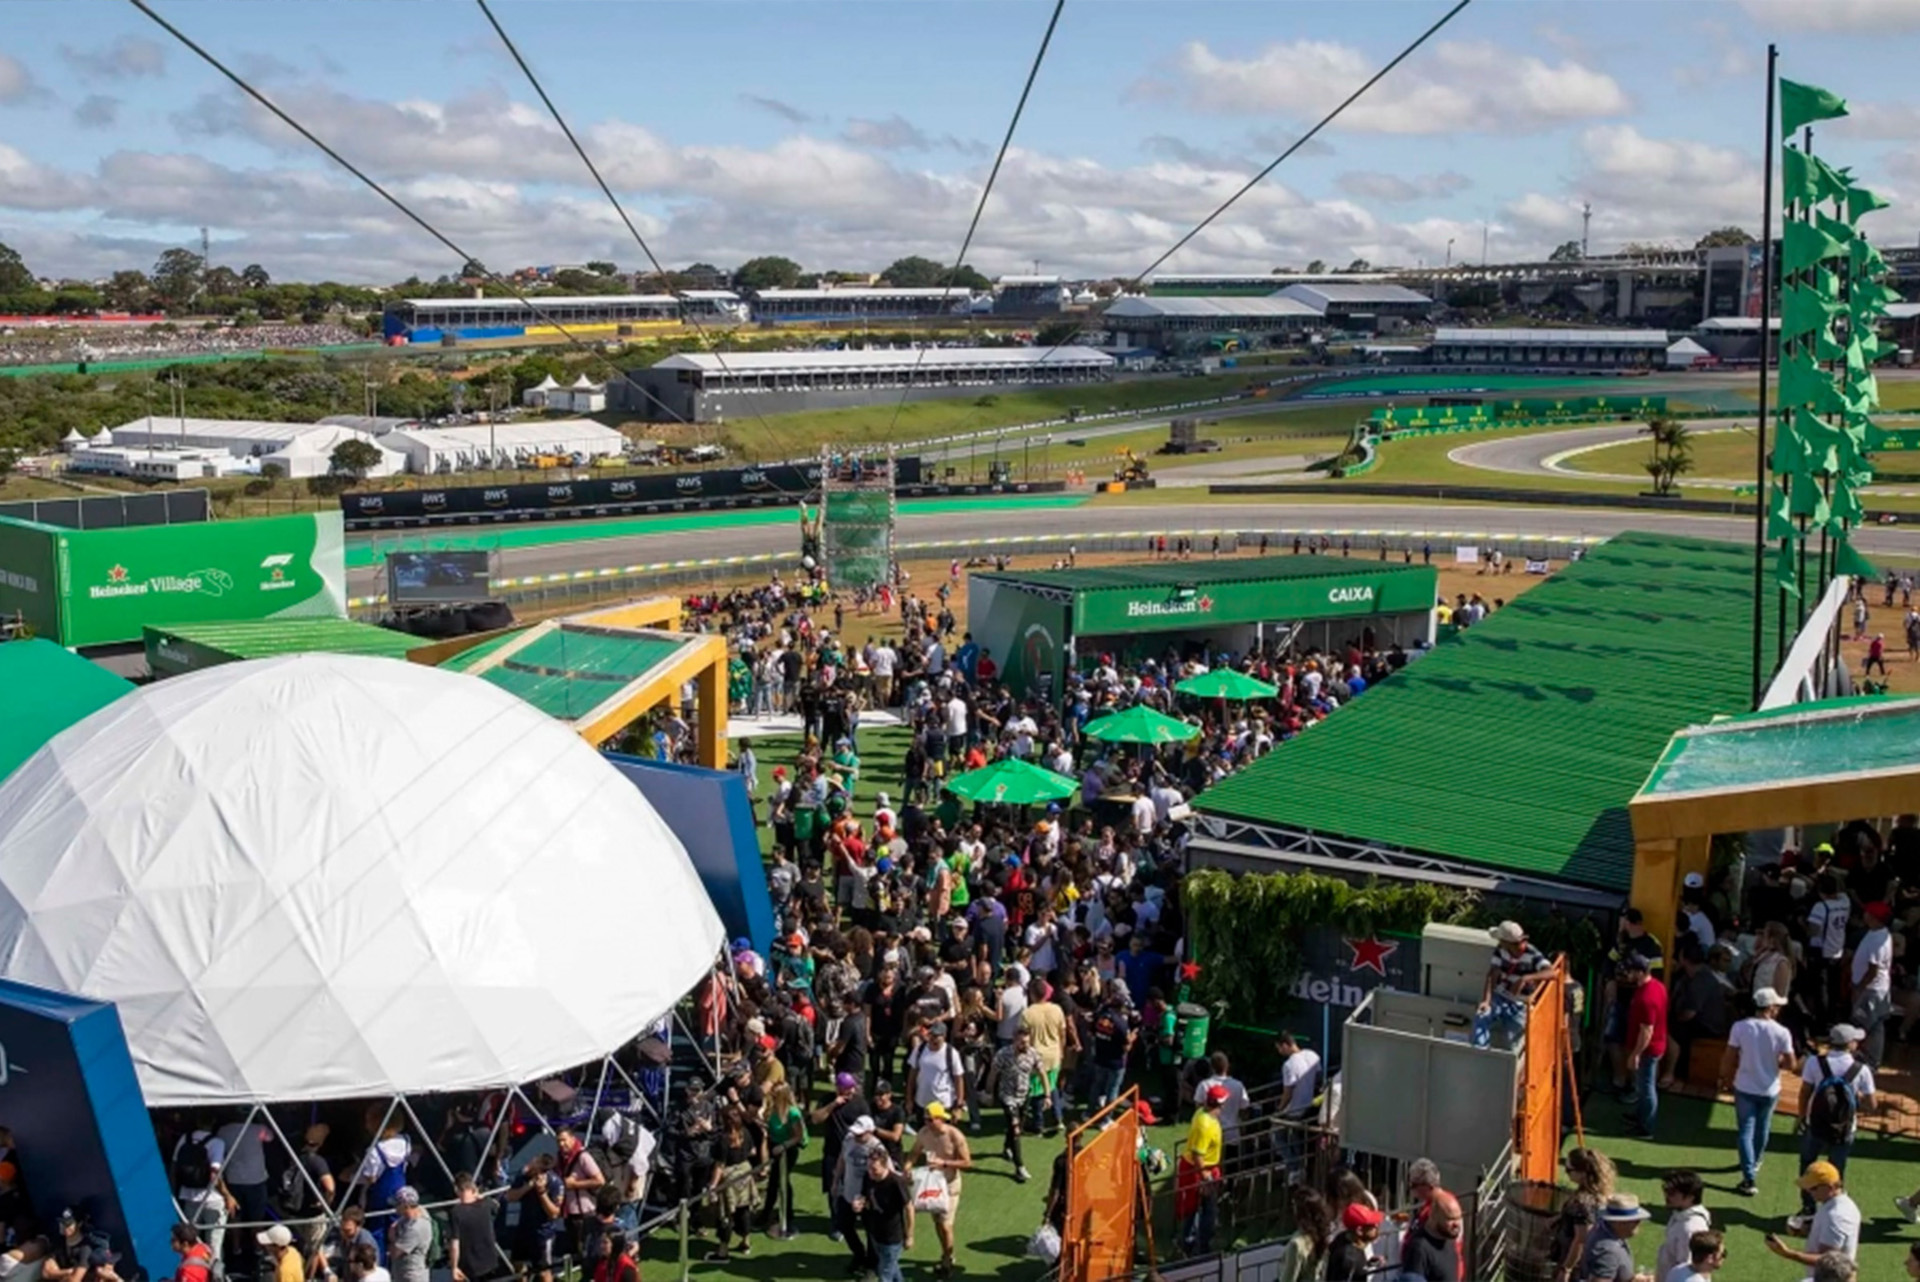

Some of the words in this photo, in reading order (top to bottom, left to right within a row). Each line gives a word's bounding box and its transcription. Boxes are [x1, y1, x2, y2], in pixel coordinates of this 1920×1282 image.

[90, 582, 148, 599] Heineken
[150, 576, 202, 593] Village
[1328, 586, 1373, 603] CAIXA
[1128, 600, 1196, 616] Heineken
